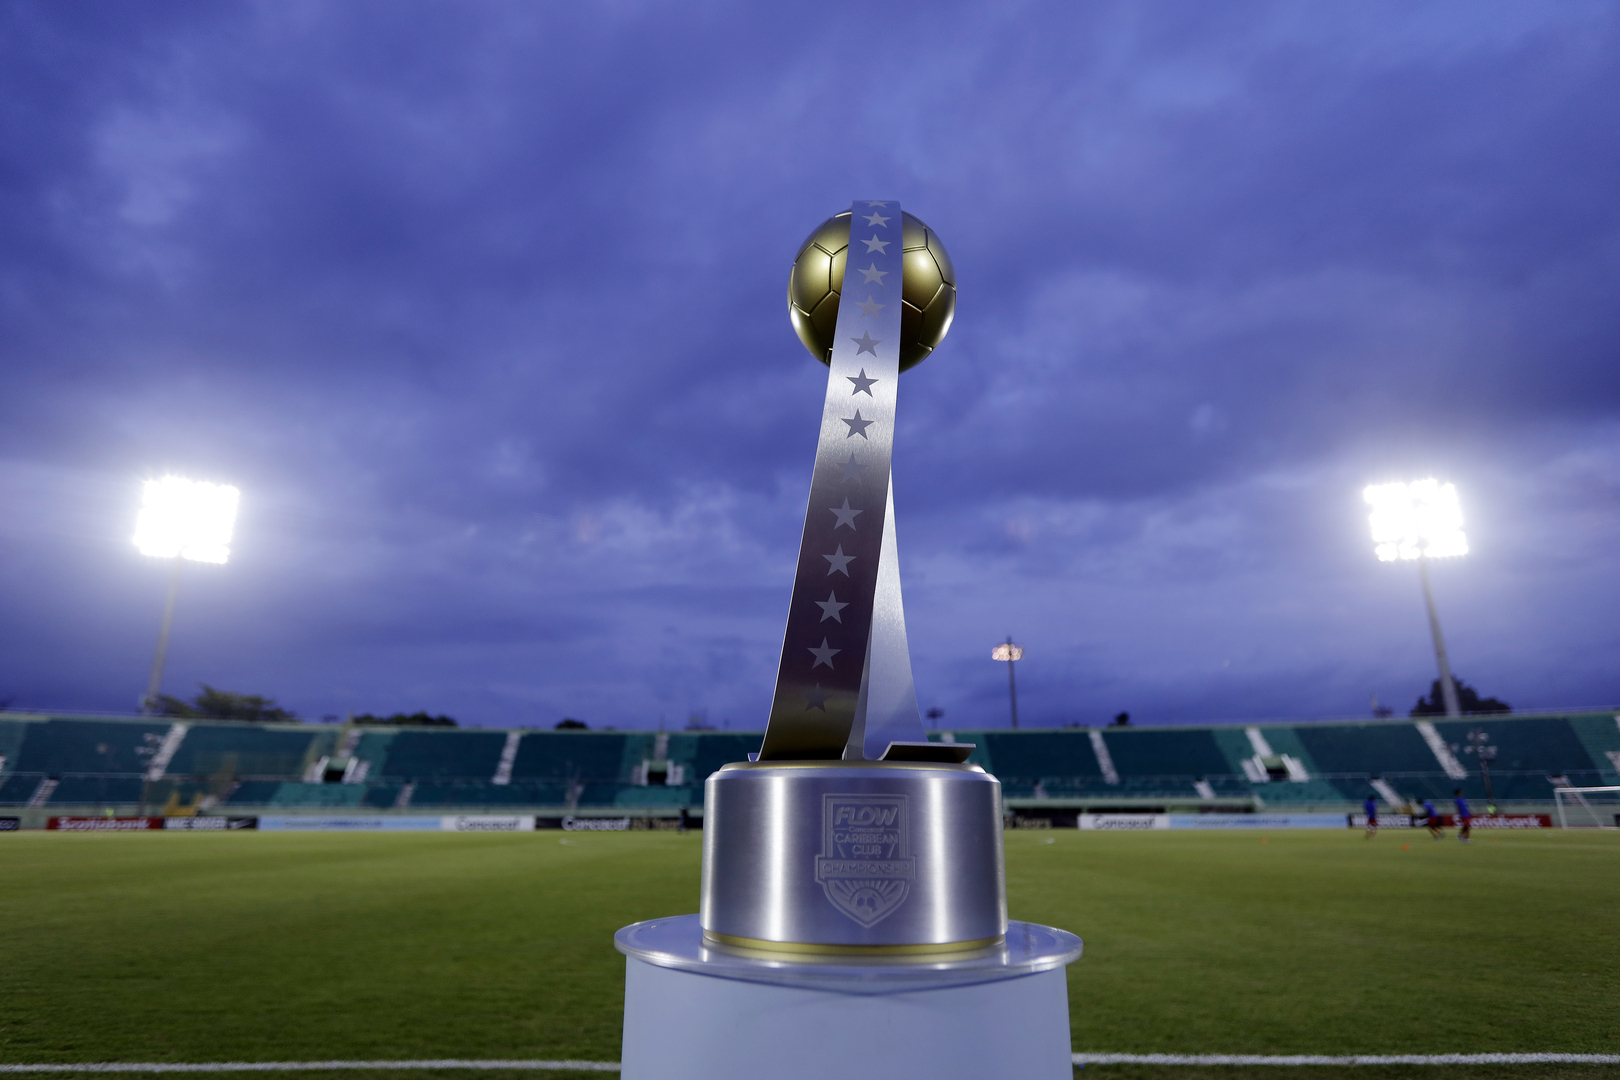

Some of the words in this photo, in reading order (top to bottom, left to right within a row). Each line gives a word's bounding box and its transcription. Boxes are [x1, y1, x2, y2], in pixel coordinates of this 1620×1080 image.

[834, 806, 898, 826] FLOW
[834, 833, 899, 844] CARIBBEAN
[851, 844, 882, 855] CLUB
[823, 863, 909, 874] CHAMPIONSHIP
